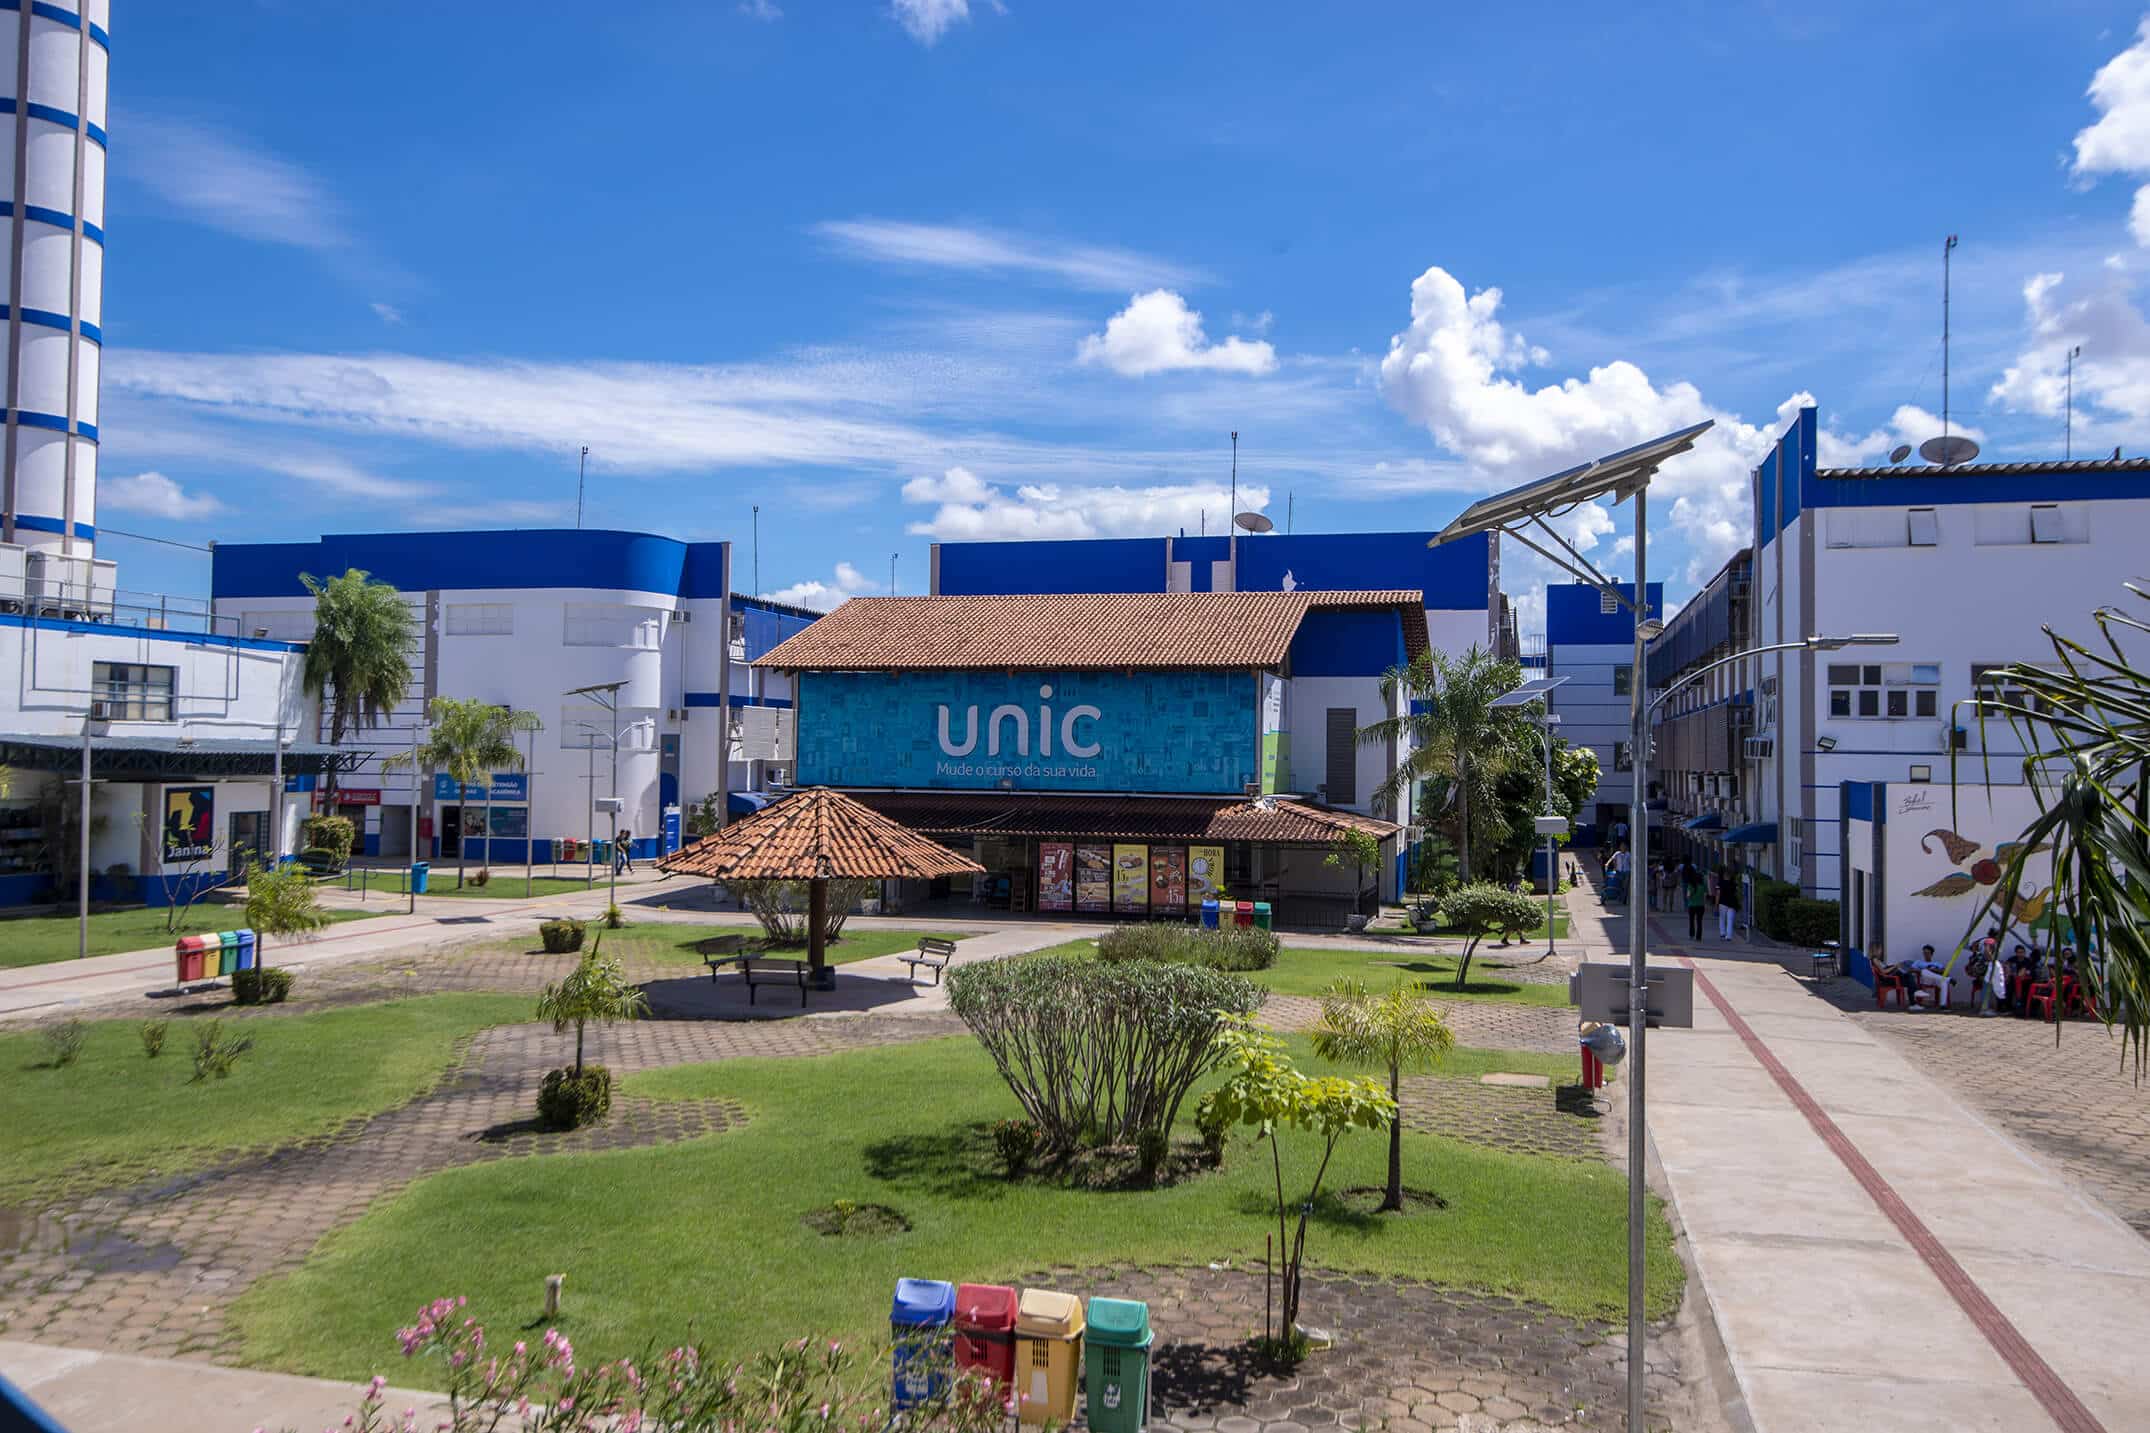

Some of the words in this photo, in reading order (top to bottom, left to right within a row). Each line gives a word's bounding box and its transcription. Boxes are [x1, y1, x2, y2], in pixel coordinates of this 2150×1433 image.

[938, 685, 1101, 758] unic
[936, 762, 973, 777] Mude
[975, 765, 984, 777] o
[986, 765, 1022, 777] curso
[1024, 762, 1041, 777] da
[1043, 765, 1067, 777] sua
[1068, 762, 1097, 777] vida
